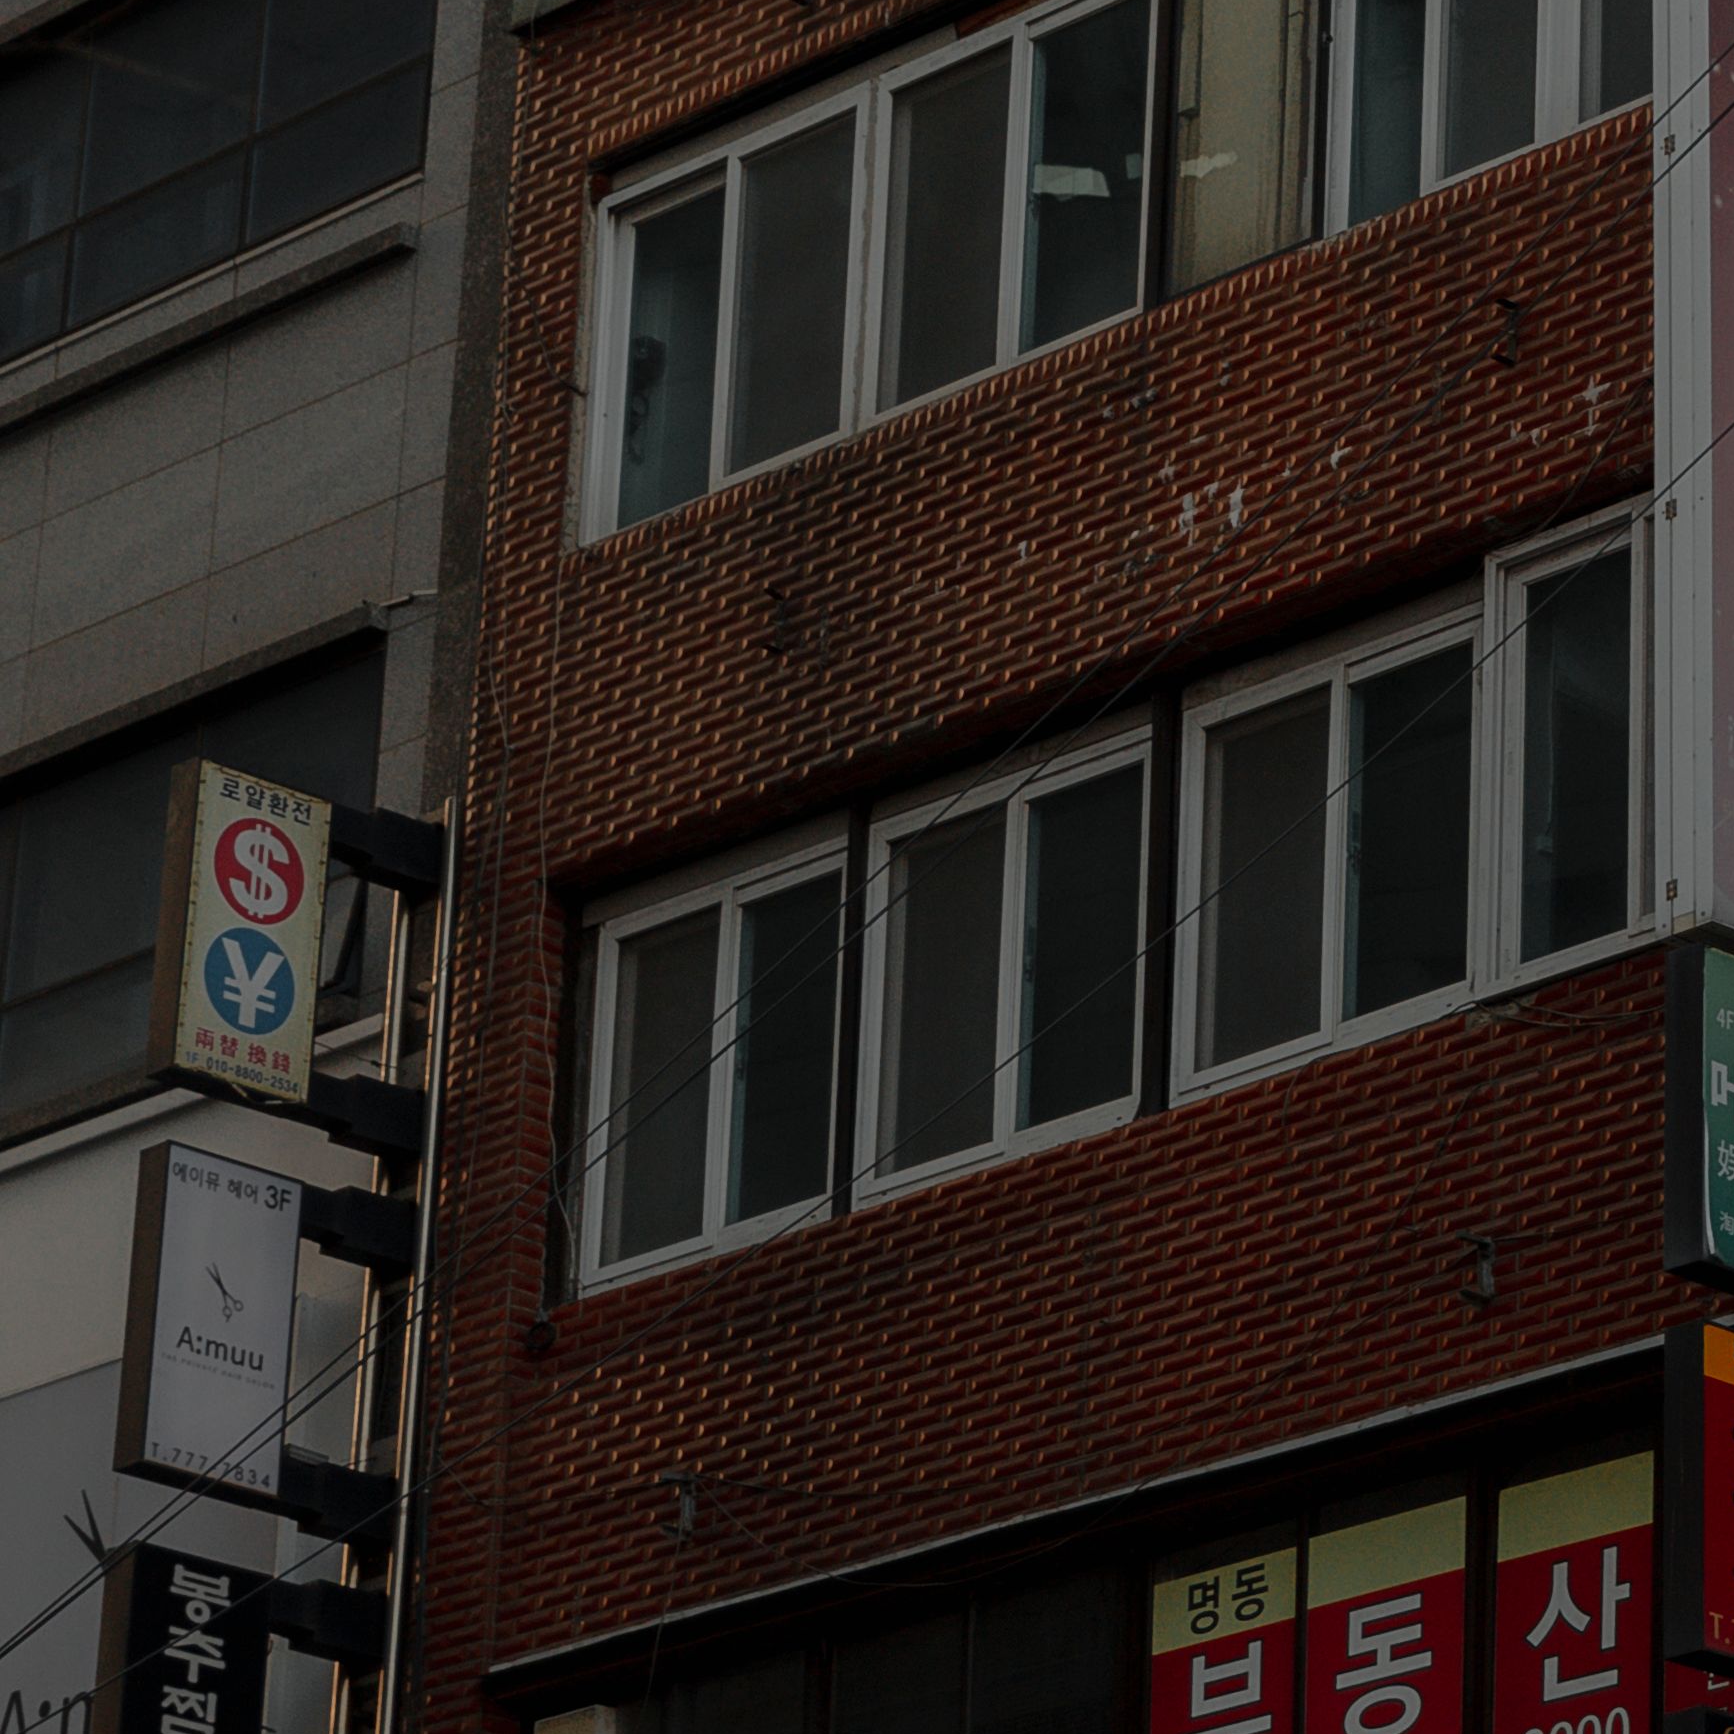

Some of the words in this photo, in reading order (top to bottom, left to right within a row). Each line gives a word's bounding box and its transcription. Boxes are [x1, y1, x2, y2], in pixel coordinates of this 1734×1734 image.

[219, 778, 312, 827] 로얄환전
[1716, 1008, 1734, 1030] 4F
[172, 1161, 221, 1190] 에이뮤
[227, 1178, 259, 1204] 헤어
[264, 1185, 292, 1211] 3F
[176, 1327, 264, 1372] A:muu
[1186, 1562, 1269, 1634] 명동
